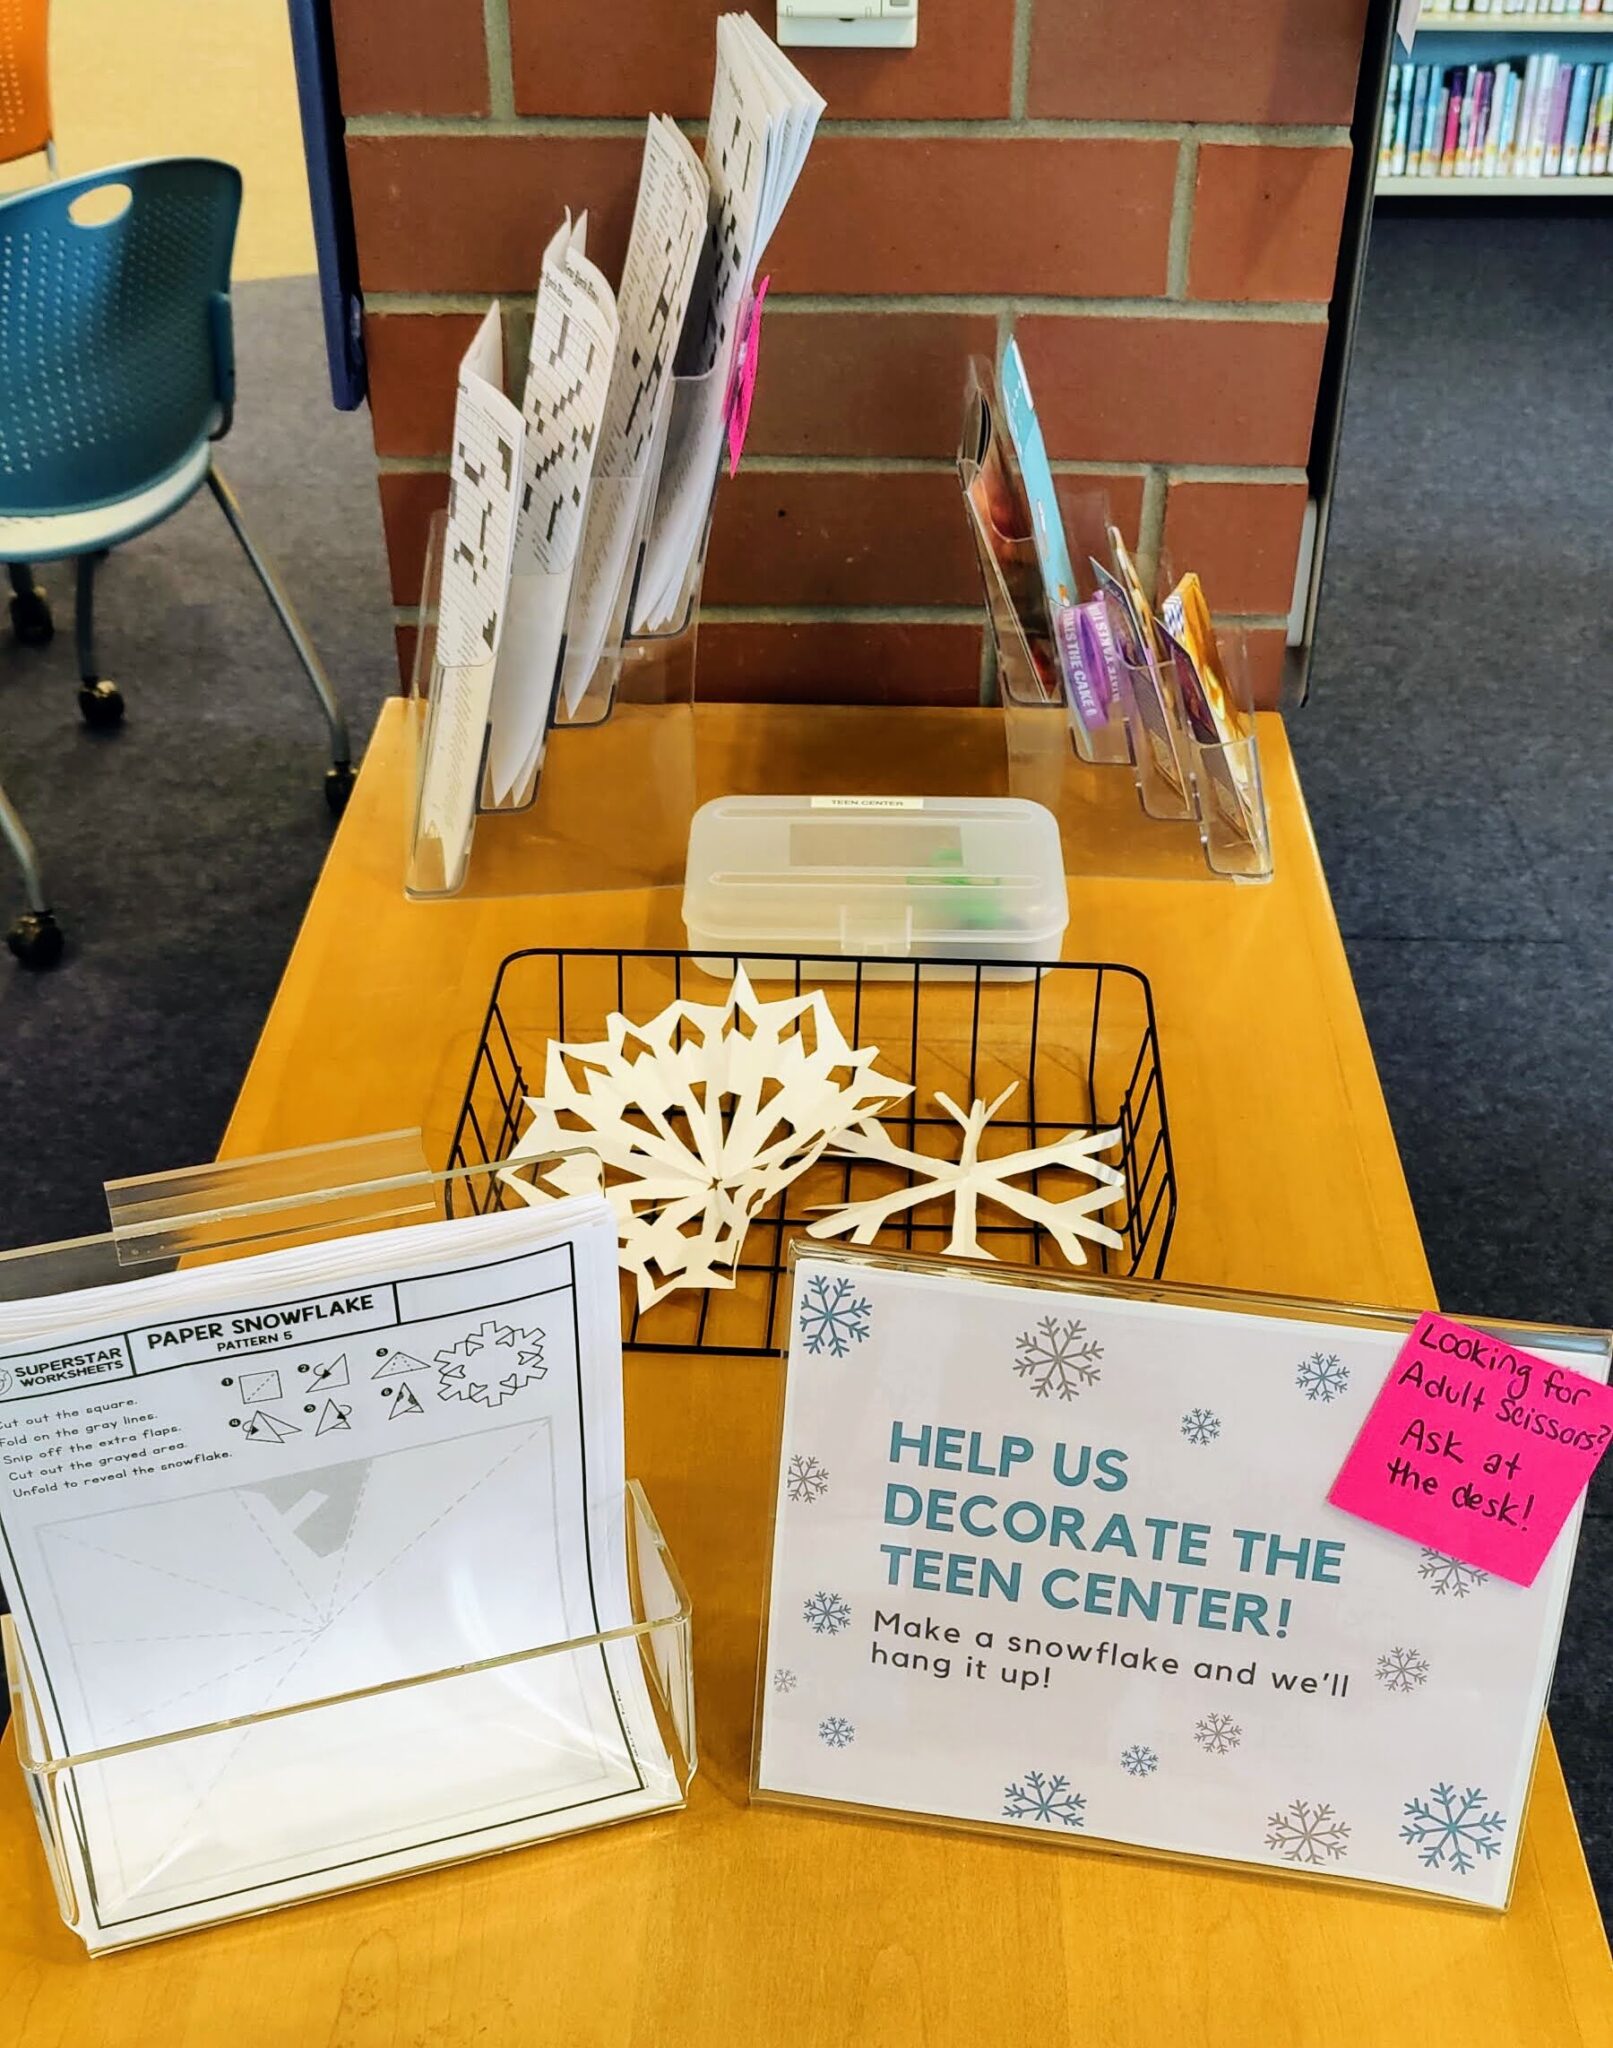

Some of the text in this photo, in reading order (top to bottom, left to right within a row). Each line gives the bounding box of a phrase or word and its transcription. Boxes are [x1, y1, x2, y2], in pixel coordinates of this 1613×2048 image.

[1067, 641, 1083, 669] THE
[1073, 670, 1096, 707] CAKE
[147, 1294, 374, 1350] PAPER SNOWFLAKE
[217, 1331, 293, 1352] PATTERN 5
[15, 1348, 122, 1378] SUPERSTAR
[20, 1360, 124, 1387] WORKSHEETS
[1398, 1360, 1485, 1412] Adult
[1419, 1323, 1592, 1405] Looking for
[0, 1413, 158, 1448] Fold on the gray lines.
[26, 1414, 49, 1425] out
[55, 1408, 79, 1420] the
[86, 1399, 138, 1414] square.
[3, 1425, 182, 1465] Snip off the extra flaps.
[9, 1442, 187, 1481] Cut out the grayed area.
[889, 1421, 1129, 1492] HELP US
[1399, 1418, 1522, 1480] Ask at
[12, 1450, 232, 1498] Unfold to reveal the snowflake.
[1387, 1457, 1535, 1531] the desk!
[884, 1483, 1346, 1584] DECORATE THE
[880, 1544, 1292, 1639] TEEN CENTER!
[871, 1642, 1051, 1691] hang it up!
[874, 1610, 1349, 1698] Make a snowflake and we'll
